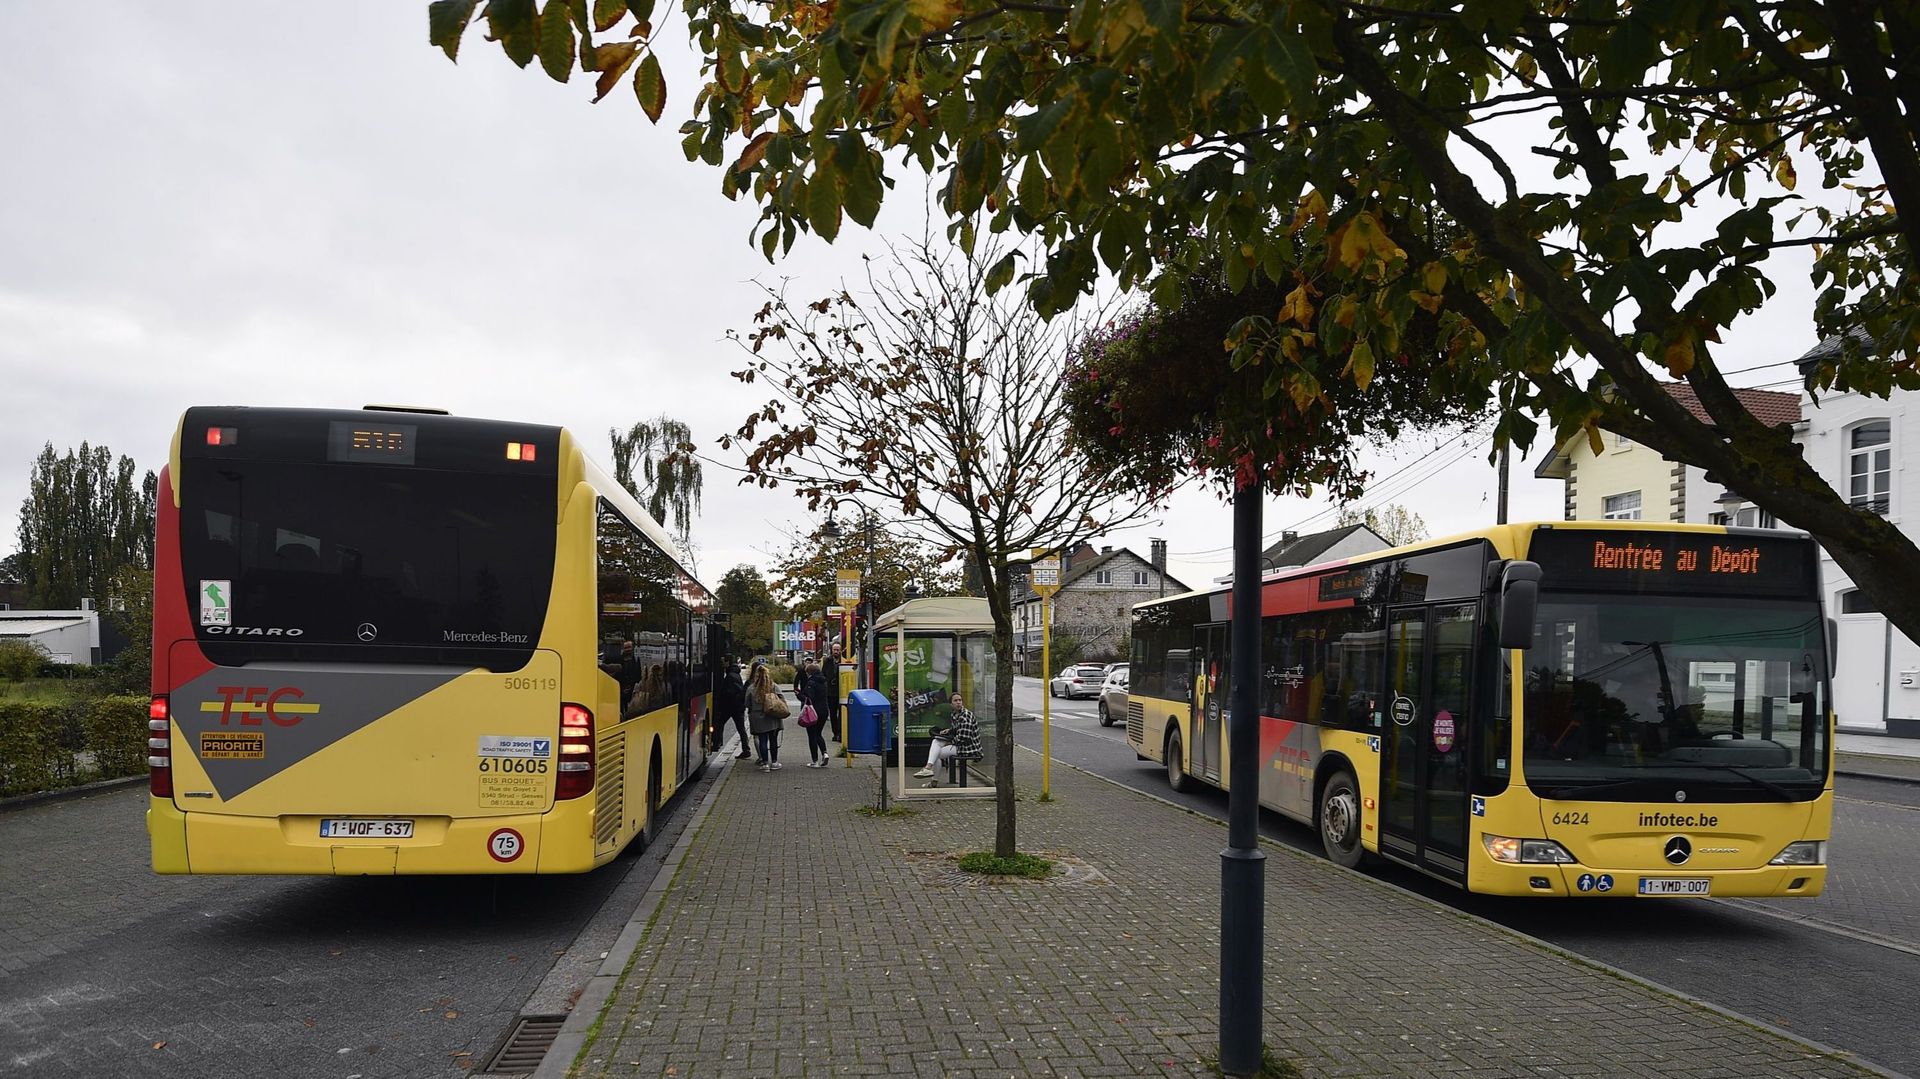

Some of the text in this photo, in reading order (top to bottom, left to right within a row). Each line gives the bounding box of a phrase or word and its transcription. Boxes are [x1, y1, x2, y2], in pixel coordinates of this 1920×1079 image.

[1594, 541, 1760, 573] Rentrée au Dépôt
[206, 626, 304, 637] CITARO
[443, 630, 528, 643] Mercedes-Benz
[779, 630, 816, 641] Bel&B
[504, 677, 557, 690] 506119
[216, 686, 305, 728] TEC
[203, 740, 261, 751] PRIORITÉ
[479, 758, 548, 773] 610605
[1552, 812, 1589, 825] 6424
[1639, 812, 1718, 827] infotec.be
[496, 836, 515, 849] 75
